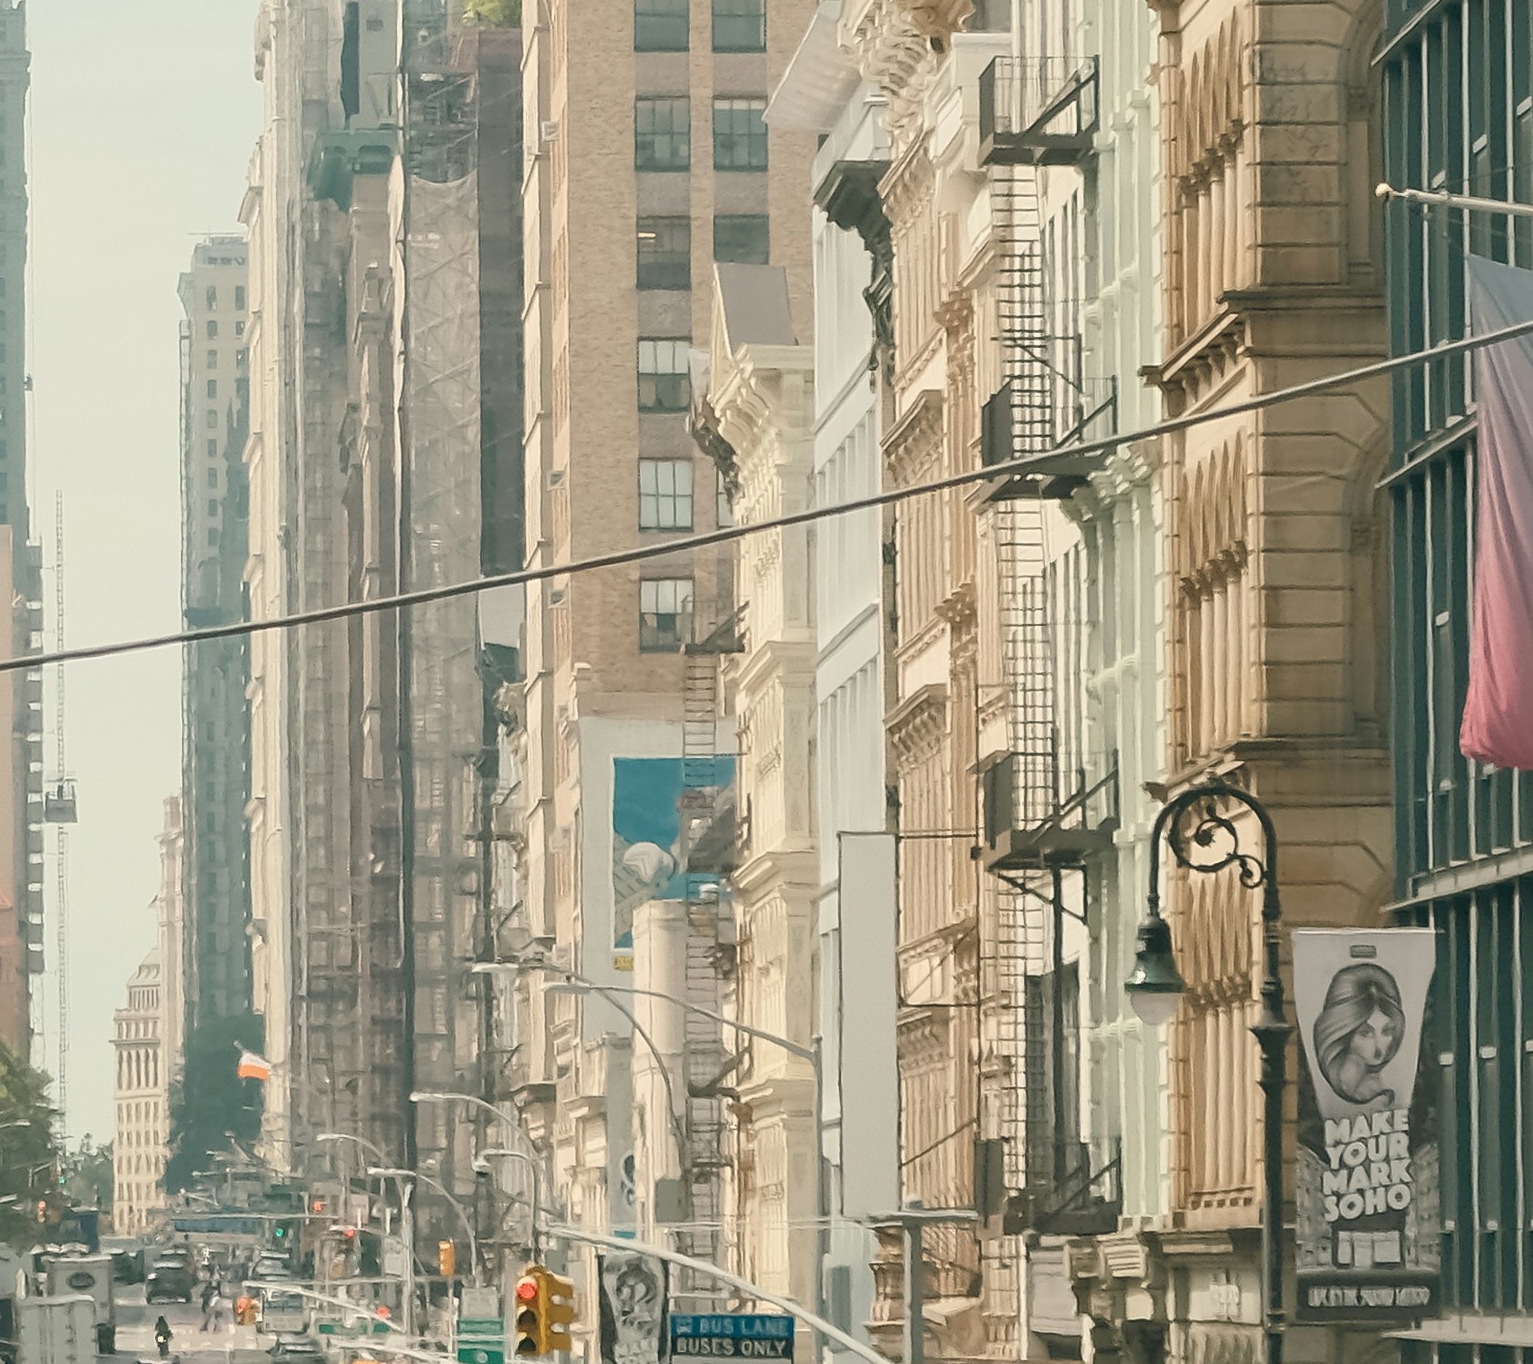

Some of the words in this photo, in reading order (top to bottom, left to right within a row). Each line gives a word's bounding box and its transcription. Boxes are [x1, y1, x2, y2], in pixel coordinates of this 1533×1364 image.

[1325, 1108, 1410, 1144] MAKE
[1326, 1133, 1410, 1170] YOUR
[1323, 1158, 1412, 1195] MARK
[1324, 1183, 1412, 1222] SOHO
[699, 1318, 734, 1335] BUS
[740, 1318, 790, 1335] LANE
[676, 1337, 735, 1355] BUSES
[741, 1340, 786, 1356] ONLY
